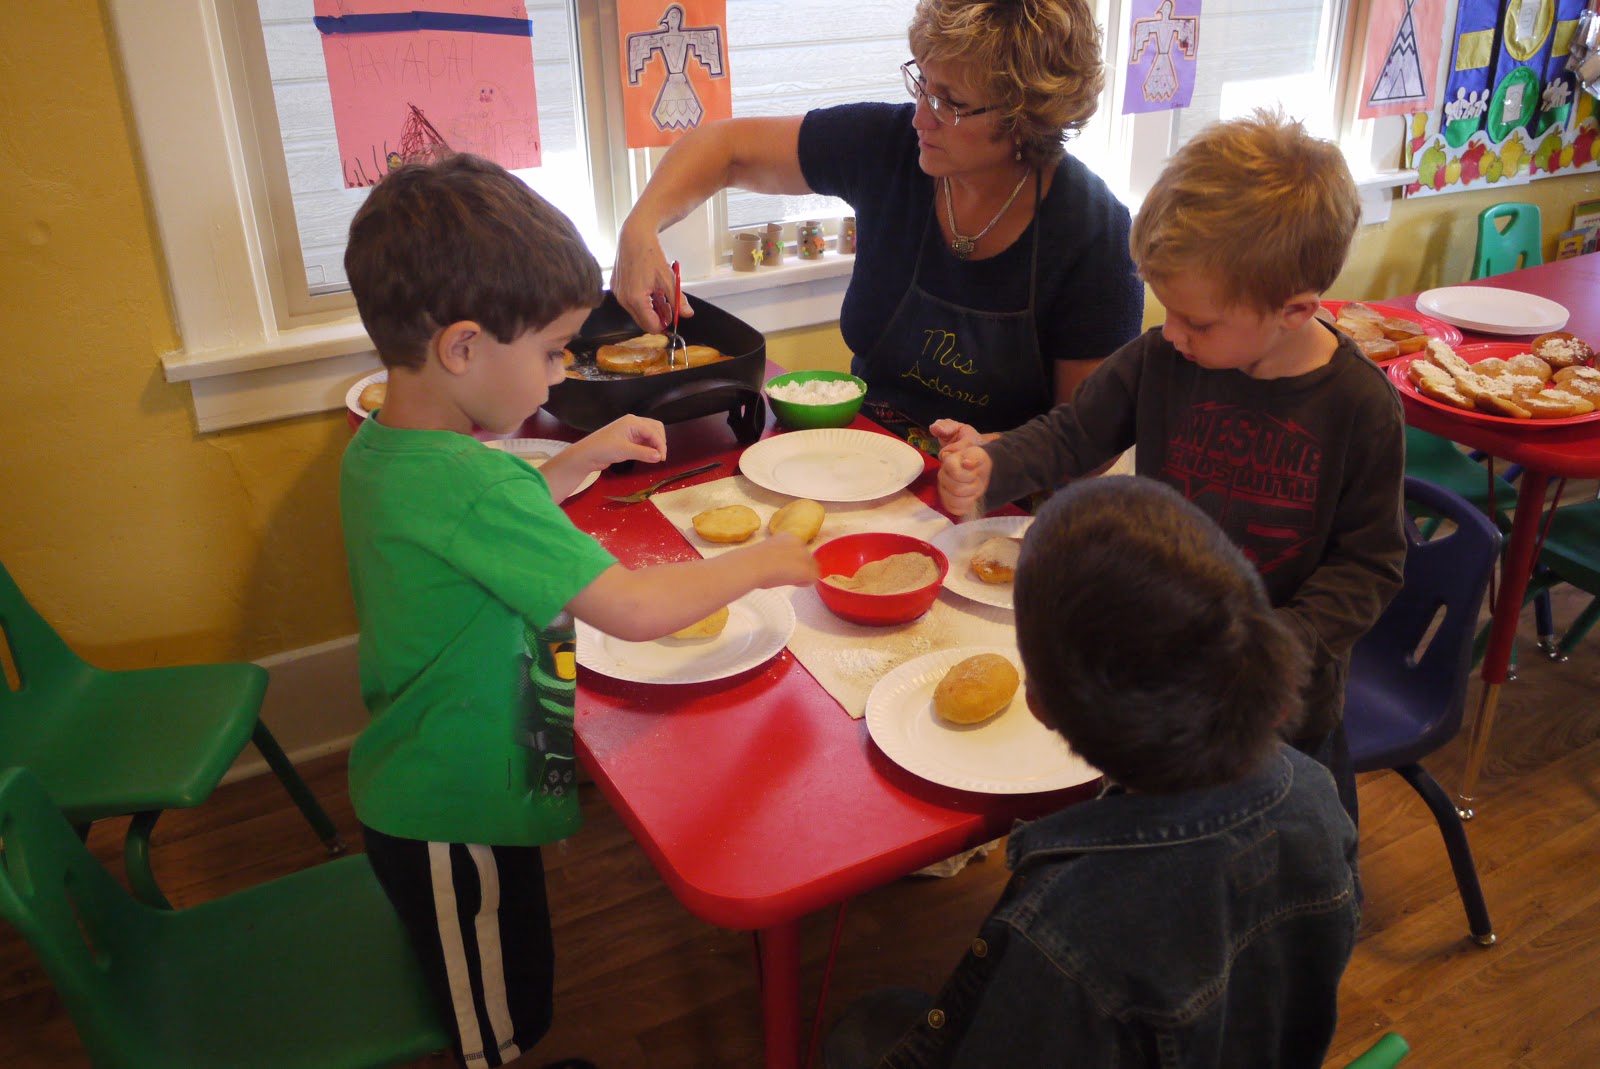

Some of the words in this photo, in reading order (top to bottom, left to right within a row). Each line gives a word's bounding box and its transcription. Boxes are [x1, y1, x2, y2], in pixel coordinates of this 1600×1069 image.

[901, 360, 990, 406] Adams
[1166, 444, 1232, 485] ENDS
[1232, 469, 1319, 503] WITH
[1168, 411, 1324, 479] AWESOME
